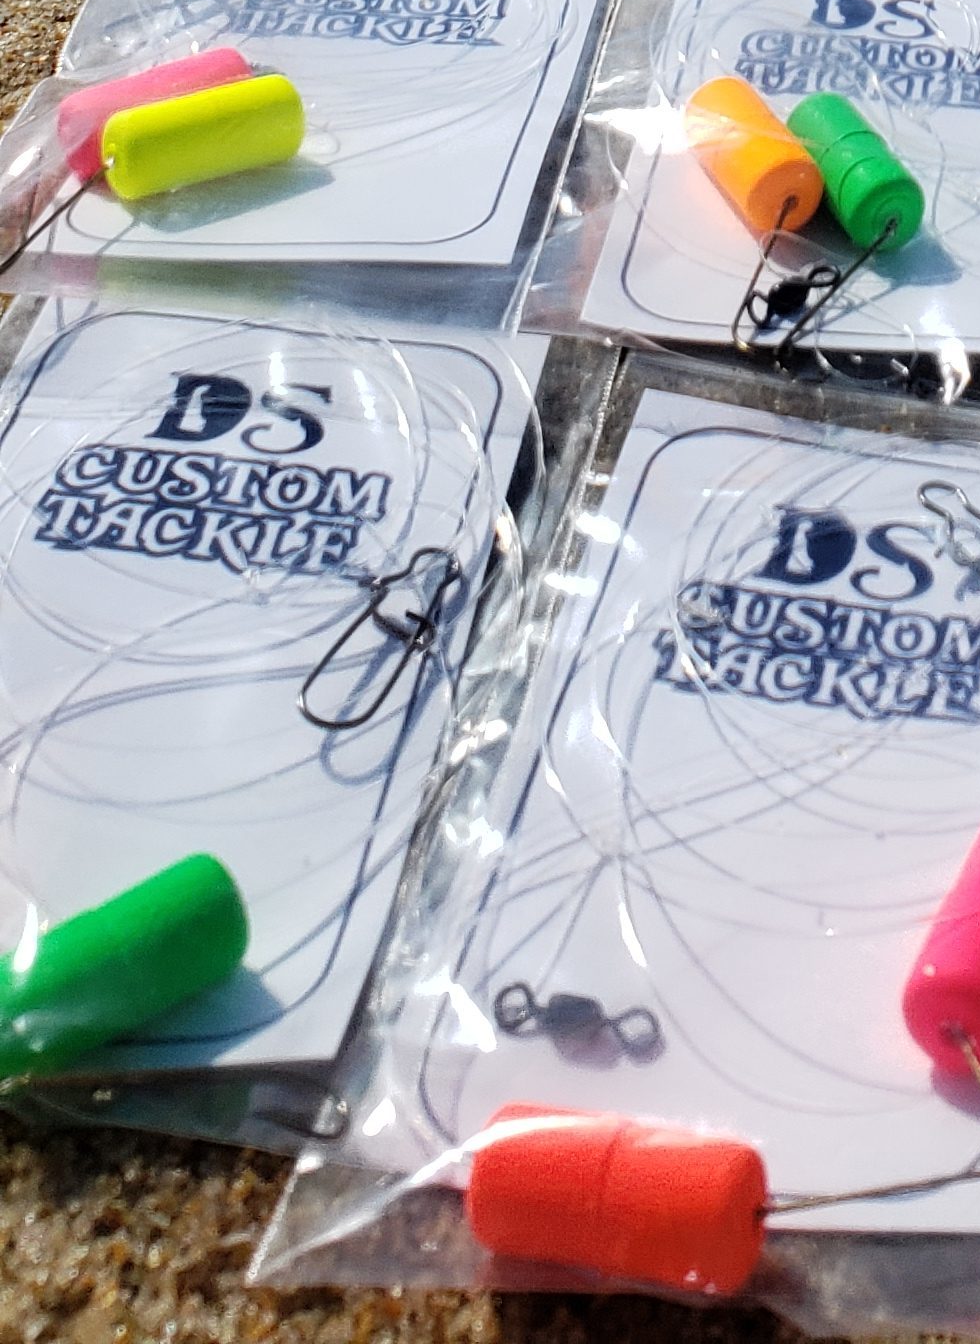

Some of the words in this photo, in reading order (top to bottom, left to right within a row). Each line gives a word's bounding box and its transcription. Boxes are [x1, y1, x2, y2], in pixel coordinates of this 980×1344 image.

[146, 371, 332, 454] DS
[56, 444, 391, 522] CUSTOM
[36, 489, 376, 579] TACKLE
[759, 505, 942, 598] DS
